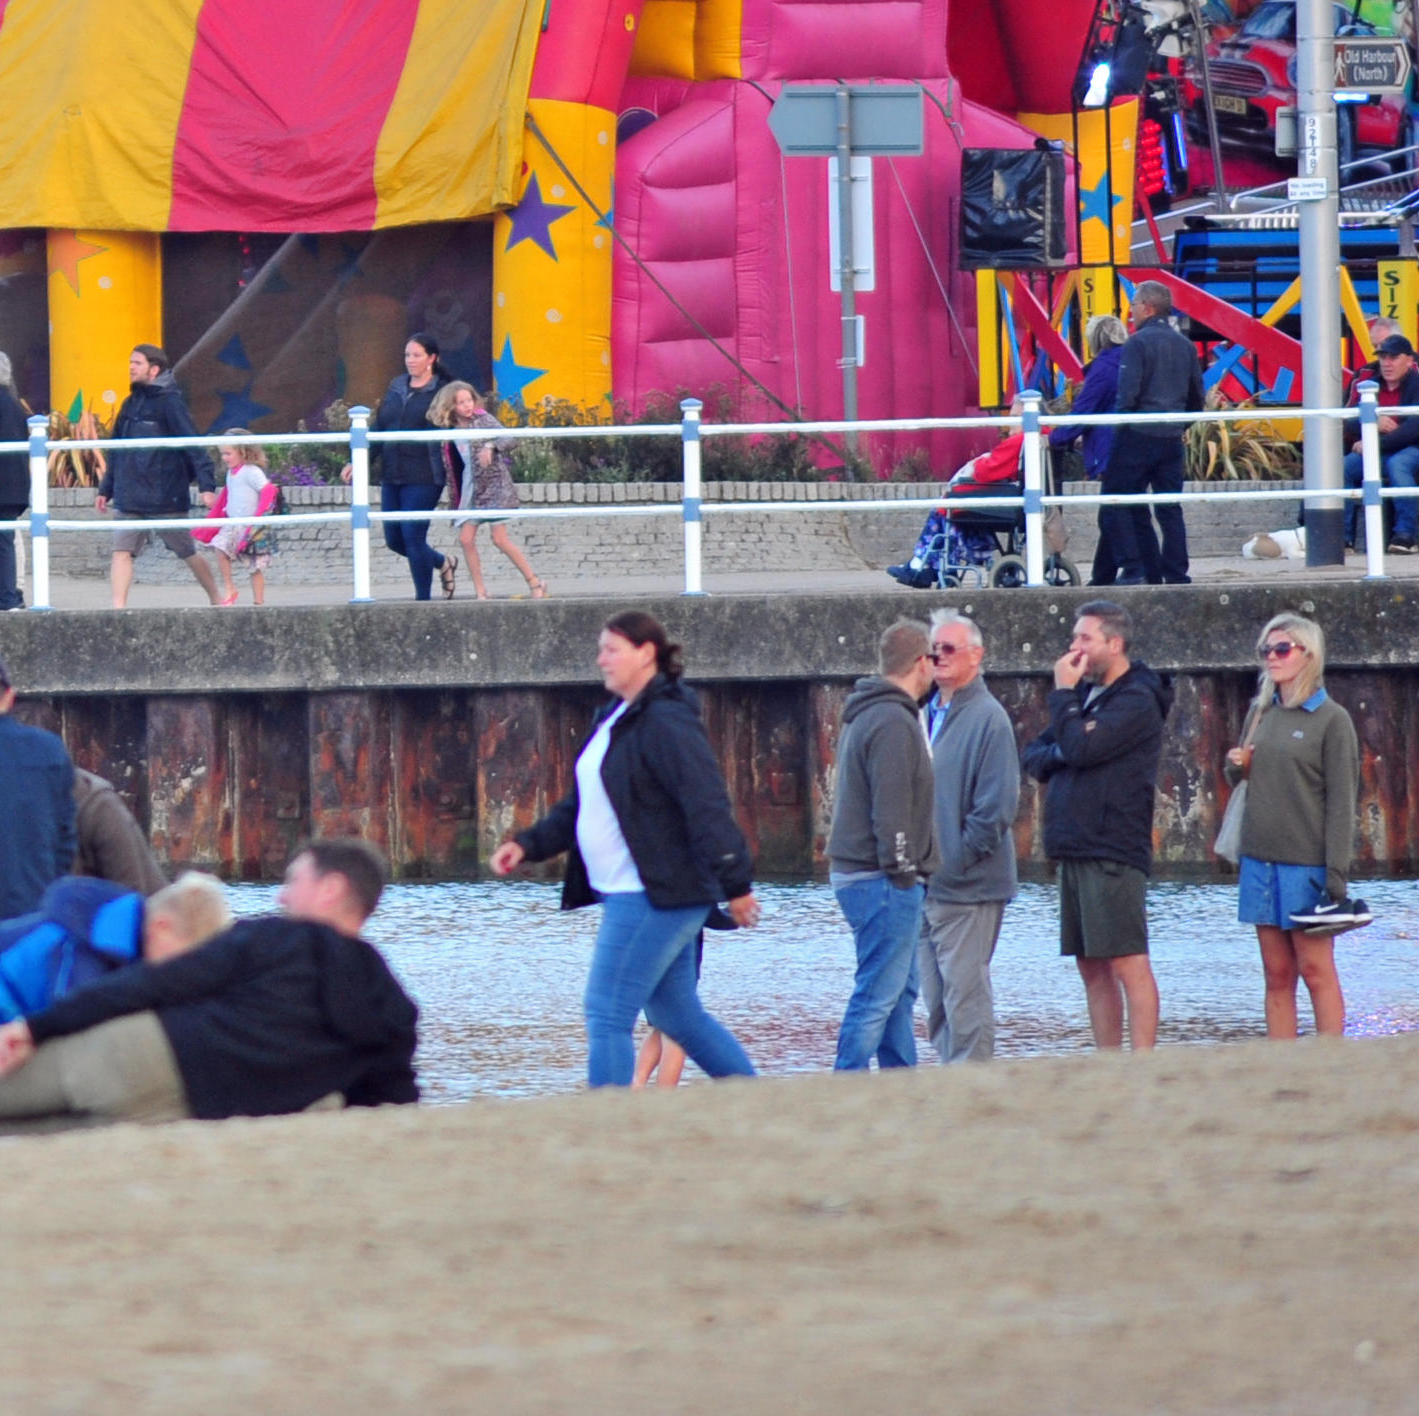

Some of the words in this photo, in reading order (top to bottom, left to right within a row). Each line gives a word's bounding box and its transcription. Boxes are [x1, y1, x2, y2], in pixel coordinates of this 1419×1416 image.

[1345, 49, 1360, 63] Old
[1362, 49, 1395, 63] Harbour
[1353, 65, 1388, 82] (North)
